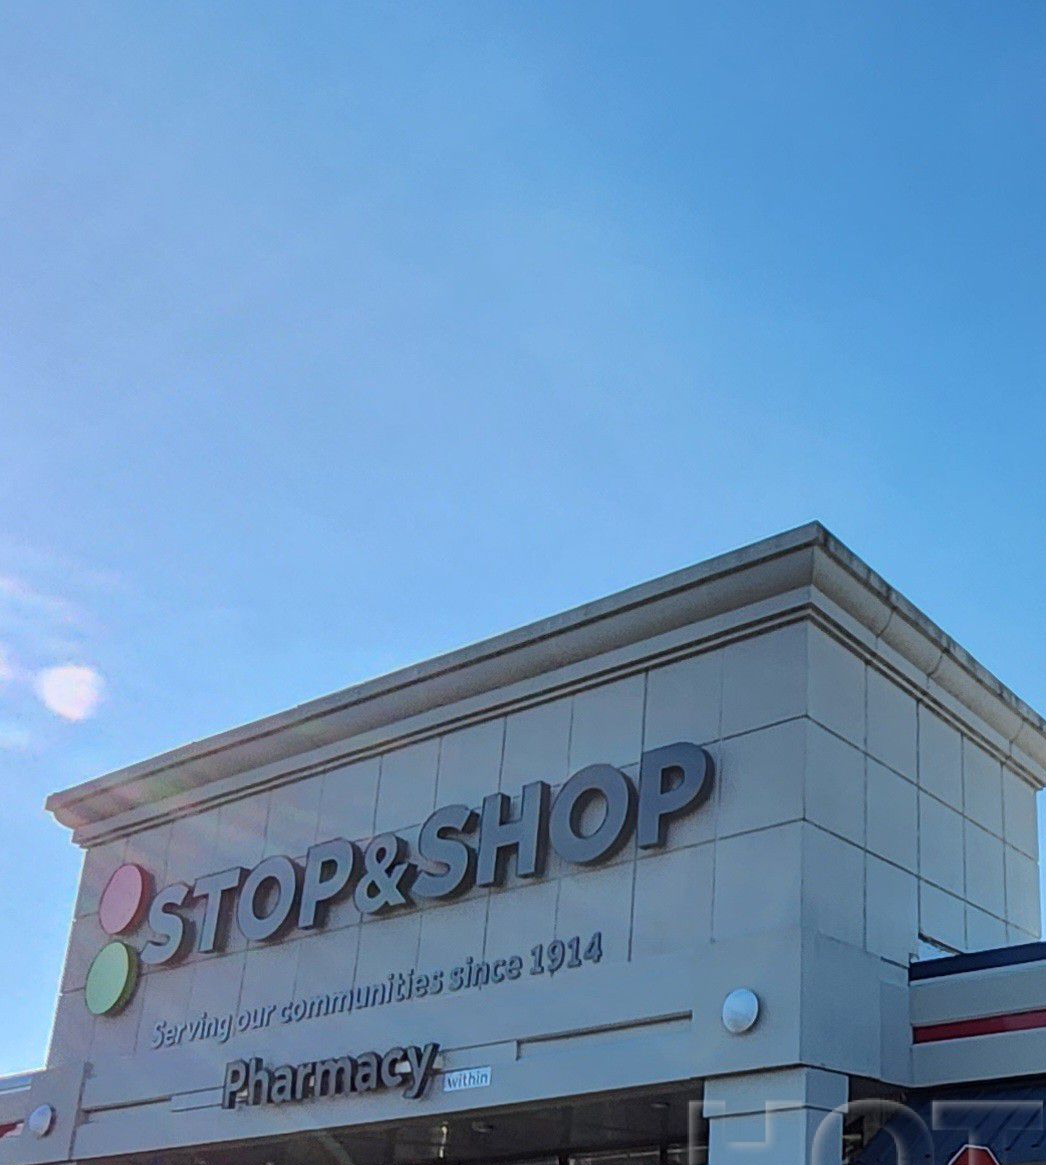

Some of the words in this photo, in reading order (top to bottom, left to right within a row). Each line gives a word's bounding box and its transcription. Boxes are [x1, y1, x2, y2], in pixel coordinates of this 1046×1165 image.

[141, 742, 714, 966] STOP&SHOP
[152, 1013, 233, 1049] Serving
[238, 1001, 275, 1032] our
[281, 971, 443, 1024] communities
[449, 956, 522, 993] since
[530, 931, 603, 977] 1914
[222, 1042, 440, 1109] Pharmacy
[447, 1071, 488, 1089] within
